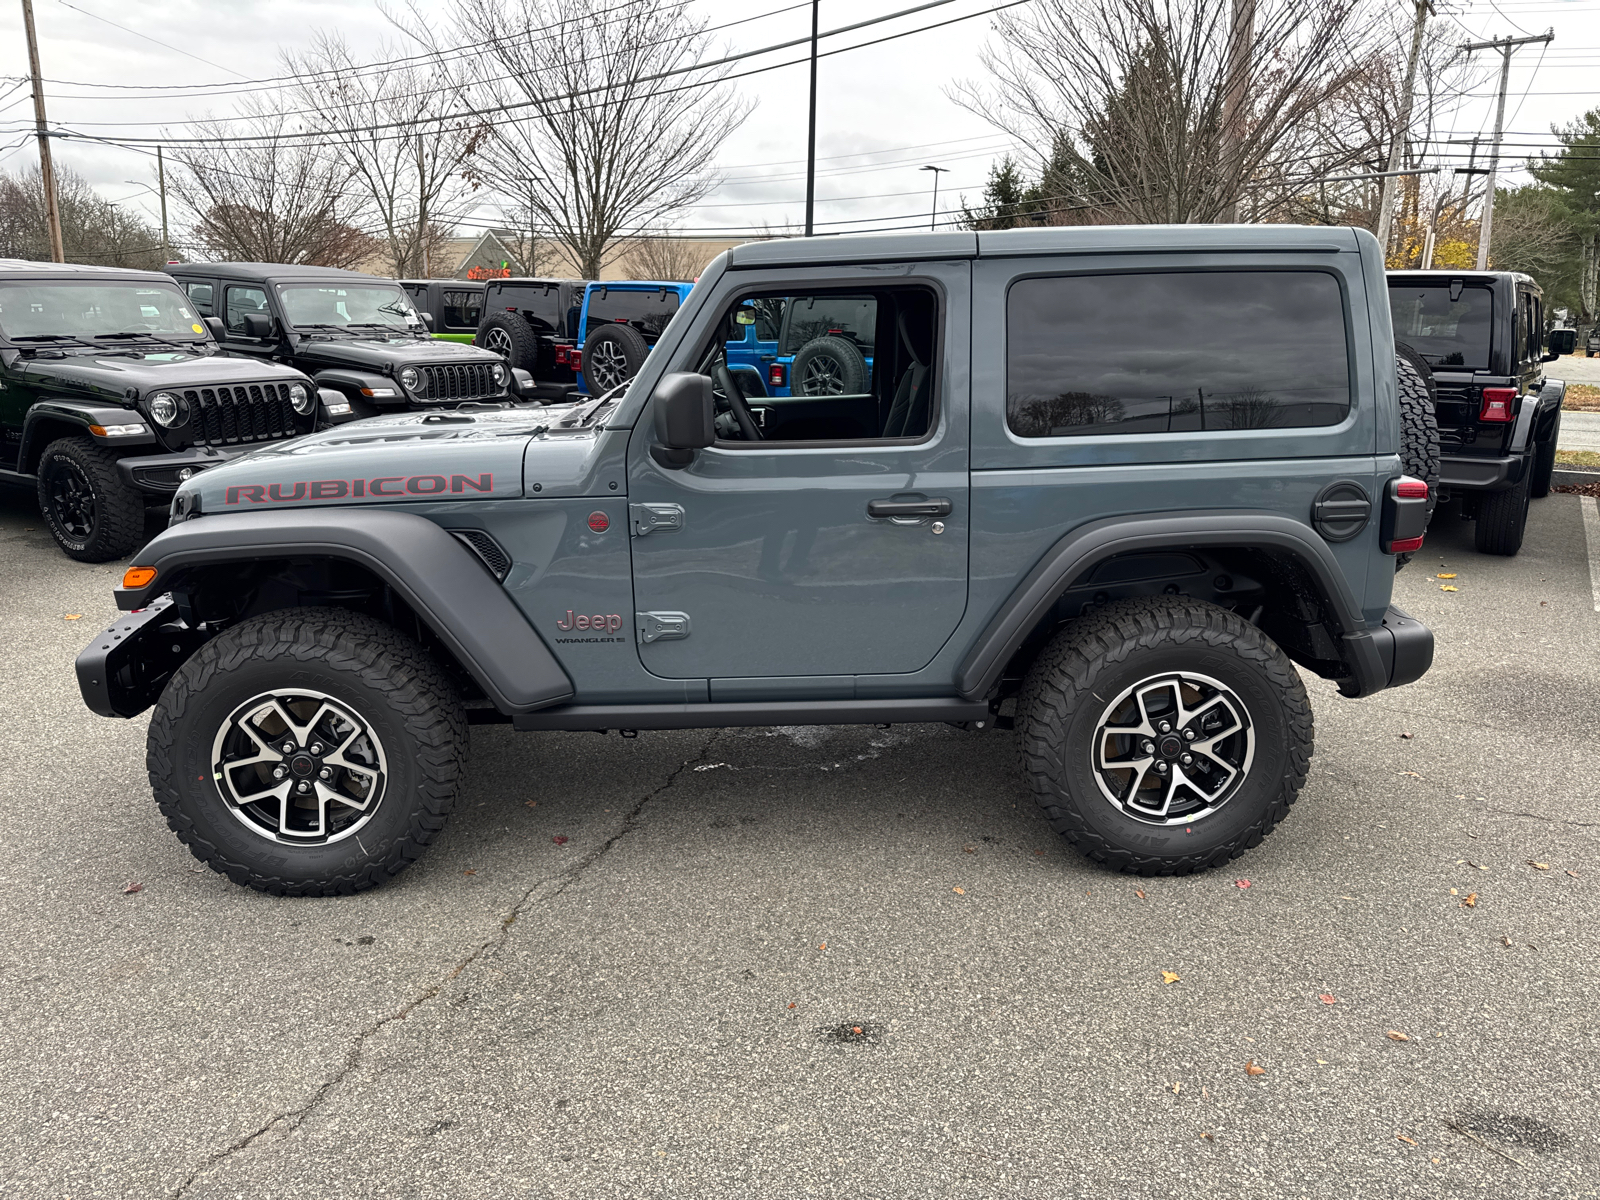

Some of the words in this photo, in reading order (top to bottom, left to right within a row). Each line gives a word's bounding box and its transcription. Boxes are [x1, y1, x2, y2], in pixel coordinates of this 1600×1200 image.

[225, 473, 494, 505] RUBICON
[556, 609, 623, 635] Jeep
[1199, 655, 1280, 790] BFGoodrich
[187, 729, 289, 868] BFGoodrich
